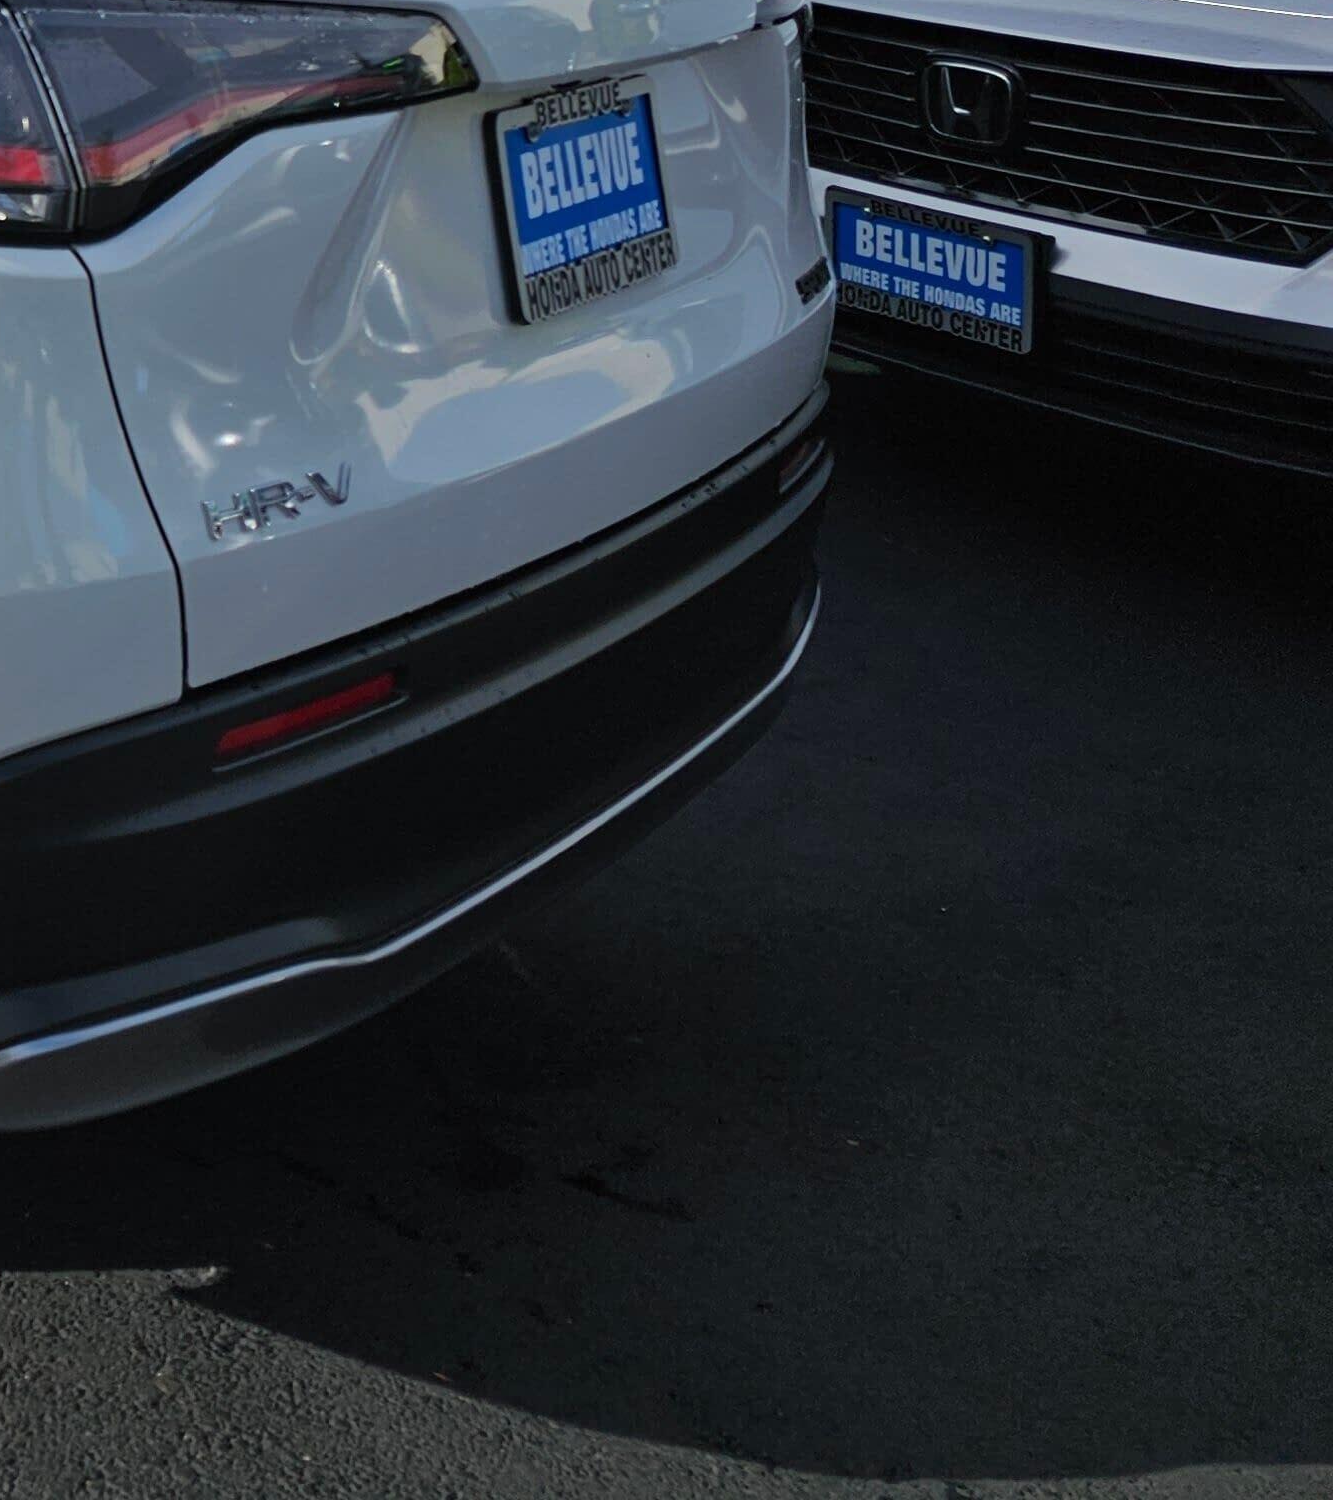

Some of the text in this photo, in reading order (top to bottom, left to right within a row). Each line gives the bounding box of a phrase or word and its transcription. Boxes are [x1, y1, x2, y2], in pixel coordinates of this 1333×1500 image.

[535, 82, 621, 127] BELLEVUE
[520, 121, 644, 220] BELLEVUE
[522, 200, 662, 274] WHERE THE HONDAS ARE
[870, 200, 982, 237] BELLEVUE
[525, 232, 678, 321] HONDA AUTO CENTER
[855, 219, 1006, 292] BELLEVUE
[840, 262, 889, 291] WHERE
[893, 276, 920, 300] THE
[924, 285, 986, 317] HONDAS
[989, 304, 1022, 326] ARE
[897, 299, 944, 329] AUTO
[949, 312, 1023, 351] CENTER
[201, 461, 351, 541] HR-V
